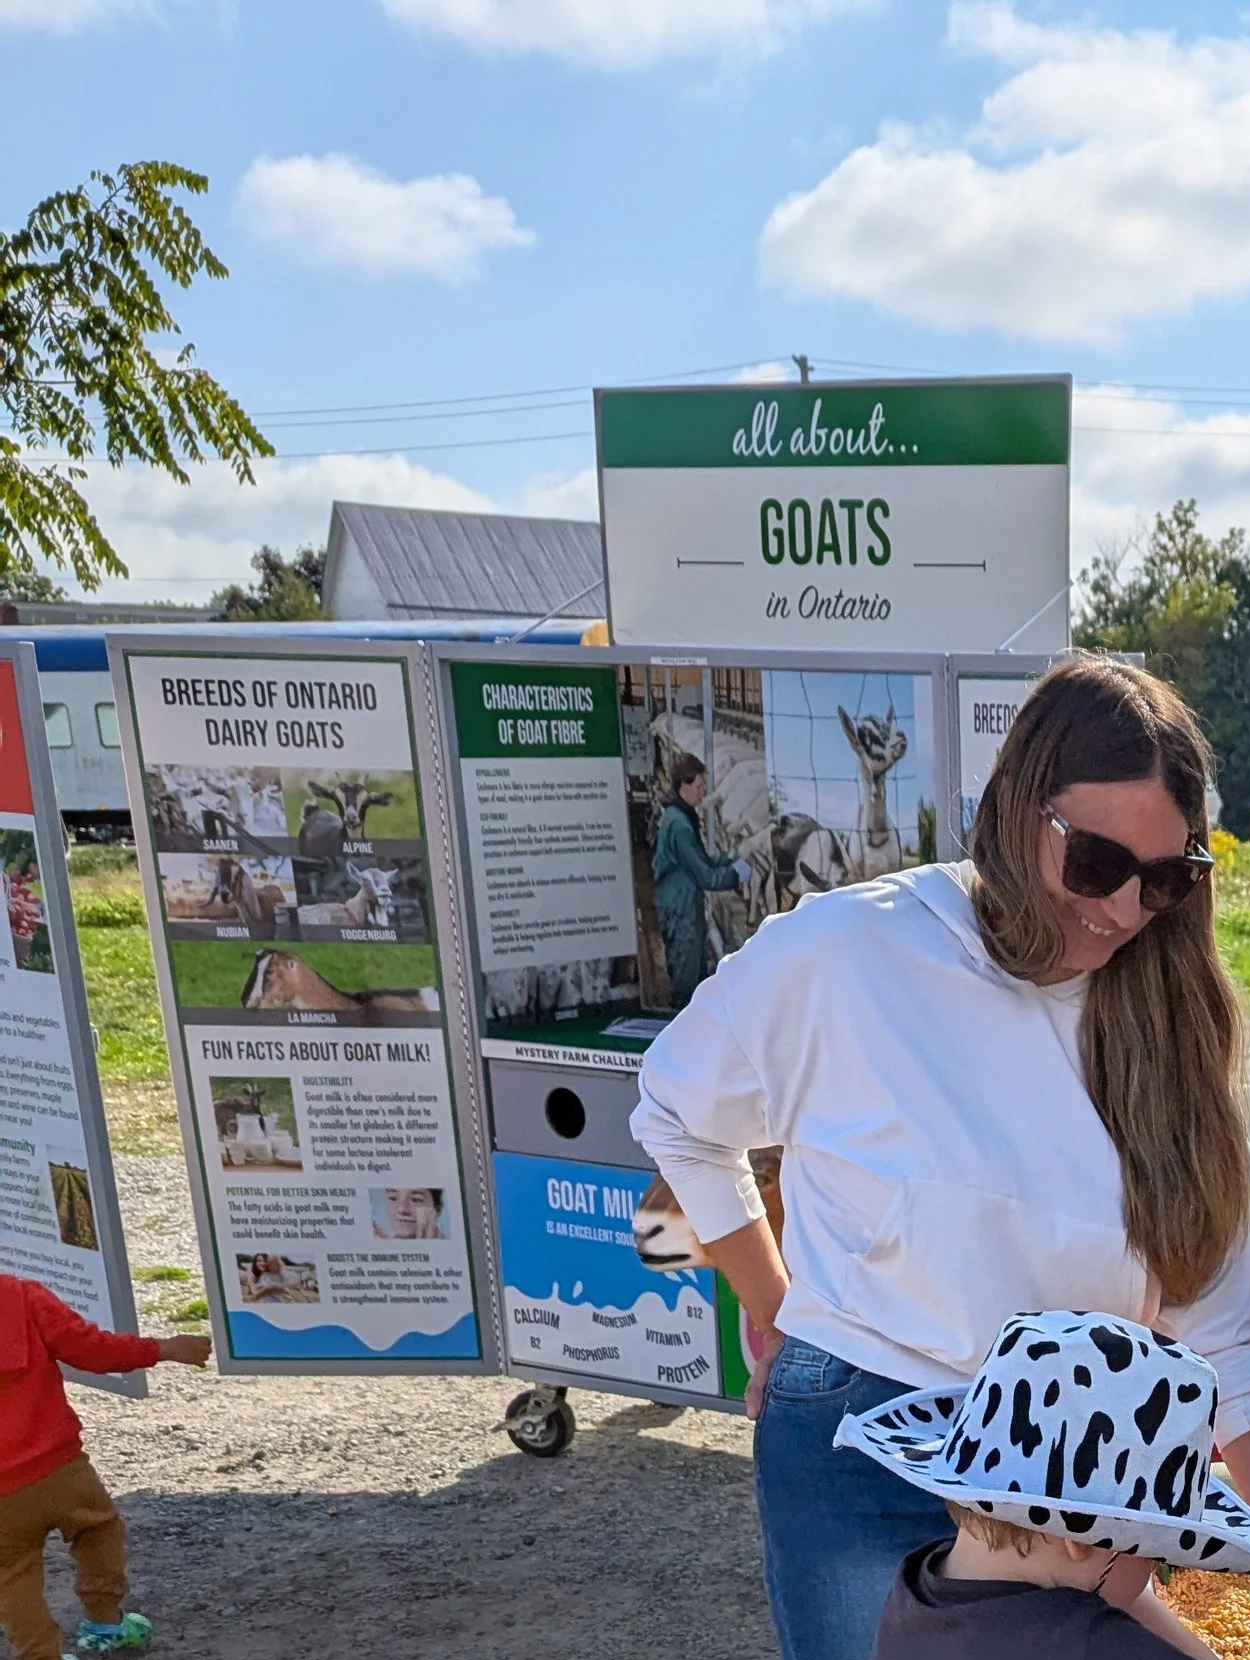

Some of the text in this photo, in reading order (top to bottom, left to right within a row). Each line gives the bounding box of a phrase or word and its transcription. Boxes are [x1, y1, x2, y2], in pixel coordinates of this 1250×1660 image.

[732, 398, 919, 458] all about...
[760, 497, 892, 567] GOATS
[765, 585, 892, 620] in Ontario
[161, 677, 377, 711] BREEDS OF ONTARIO
[482, 683, 594, 712] CHARACTERISTICS
[205, 718, 345, 749] DAIRY GOATS
[498, 718, 586, 745] OF GOAT FIBRE
[203, 838, 239, 852] SAANEN
[342, 842, 373, 855] ALPINE
[216, 926, 250, 938] NUBIAN
[340, 929, 397, 942] TOGGENBURG
[287, 1012, 337, 1025] LA MANCHA
[202, 1040, 431, 1062] FUN FACTS ABOUT GOAT MILK!
[515, 1046, 645, 1068] MYSTERY FARM CHALLENG
[305, 1091, 438, 1102] Goat milk is often considered more
[307, 1105, 432, 1117] digestible than cow's milk due to
[320, 1119, 348, 1129] smaller
[350, 1119, 361, 1129] fat
[363, 1119, 395, 1132] globules
[405, 1119, 439, 1129] different
[311, 1133, 436, 1146] protein structure making it easier
[313, 1147, 413, 1157] for some lactose intolerant
[315, 1159, 356, 1171] individuals
[358, 1161, 367, 1170] to
[226, 1186, 356, 1198] POTENTIAL FOR BETTER SKIN HEALTH
[547, 1178, 644, 1221] GOAT MIL
[228, 1200, 349, 1214] The fatty acids in goat milk may
[231, 1214, 355, 1227] have moisturizing properties that
[233, 1228, 252, 1239] could
[254, 1228, 281, 1239] benefit
[283, 1229, 298, 1239] skin
[546, 1220, 637, 1247] IS AN EXCELLENT SOU
[327, 1253, 355, 1262] BOOSTS
[356, 1253, 370, 1262] THE
[402, 1253, 430, 1262] SYSTEM
[329, 1267, 347, 1277] Goat
[349, 1267, 366, 1277] milk
[368, 1268, 398, 1277] contains
[400, 1267, 433, 1277] selenium
[443, 1267, 463, 1277] other
[331, 1280, 460, 1292] antioxidants that may contribute to
[340, 1293, 388, 1306] strengthened
[390, 1295, 420, 1303] immune
[513, 1308, 561, 1329] CALCIUM
[592, 1311, 638, 1328] MAGNESIUM
[687, 1305, 703, 1320] B12
[530, 1336, 541, 1350] B2
[645, 1328, 691, 1346] VITAMIN D
[563, 1343, 621, 1362] PHOSPHORUS
[657, 1355, 711, 1384] PROTEIN
